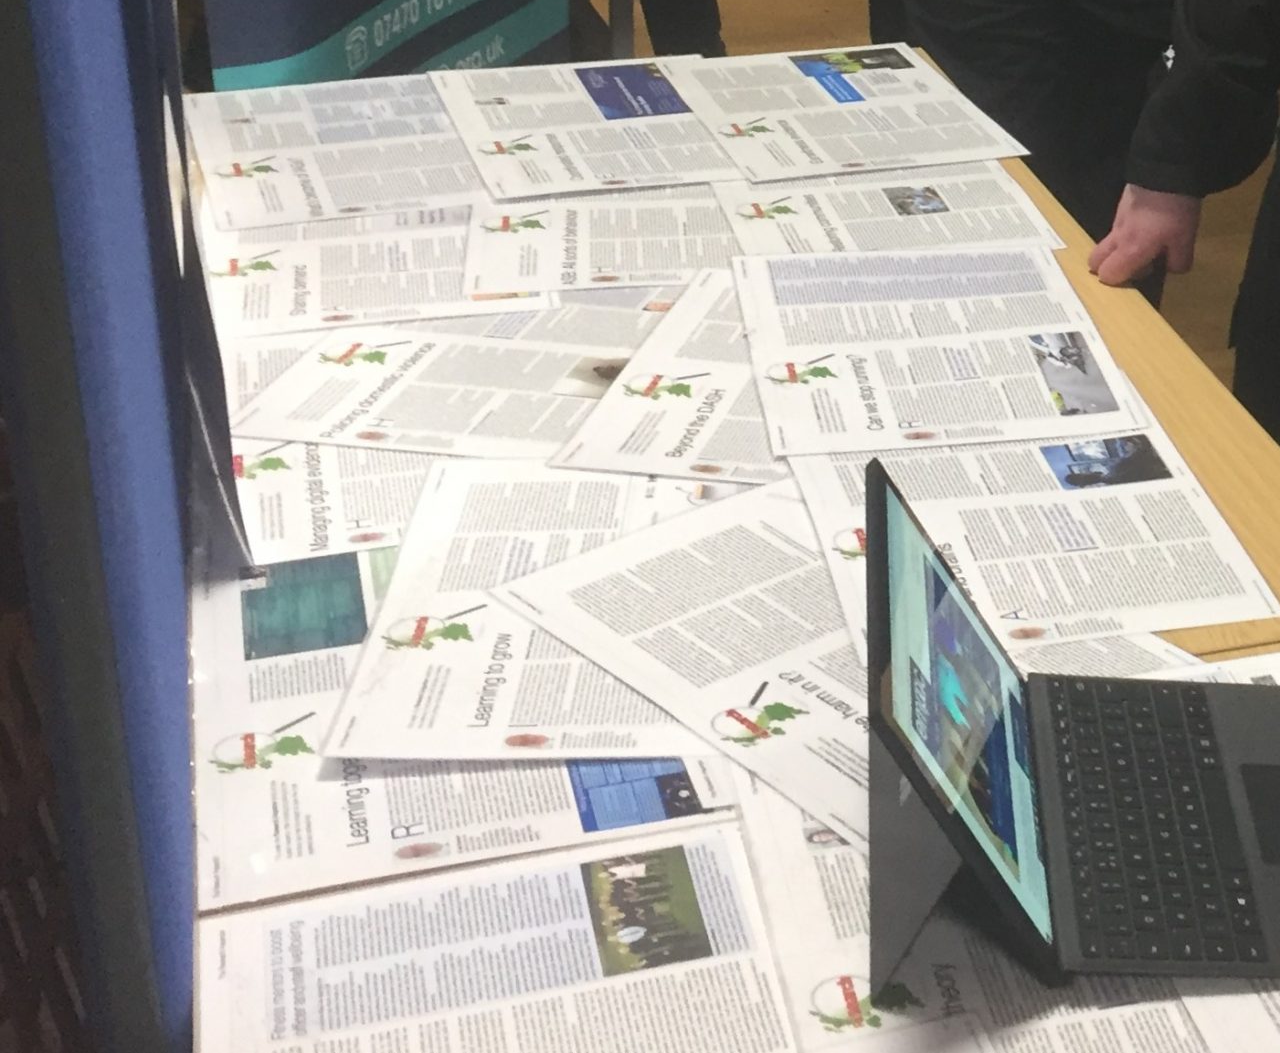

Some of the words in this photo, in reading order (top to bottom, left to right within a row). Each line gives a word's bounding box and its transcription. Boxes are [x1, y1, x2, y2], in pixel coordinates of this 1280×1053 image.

[696, 388, 726, 414] DASH
[858, 385, 877, 402] stop
[687, 413, 710, 428] the
[863, 402, 878, 415] we
[866, 415, 884, 432] Can
[664, 428, 701, 458] Beyond
[305, 479, 330, 505] digital
[308, 506, 332, 552] Managing
[489, 632, 513, 661] grow
[483, 662, 505, 676] to
[801, 680, 820, 694] in
[466, 676, 506, 728] Learning
[815, 690, 858, 720] harm
[342, 787, 370, 848] Learning
